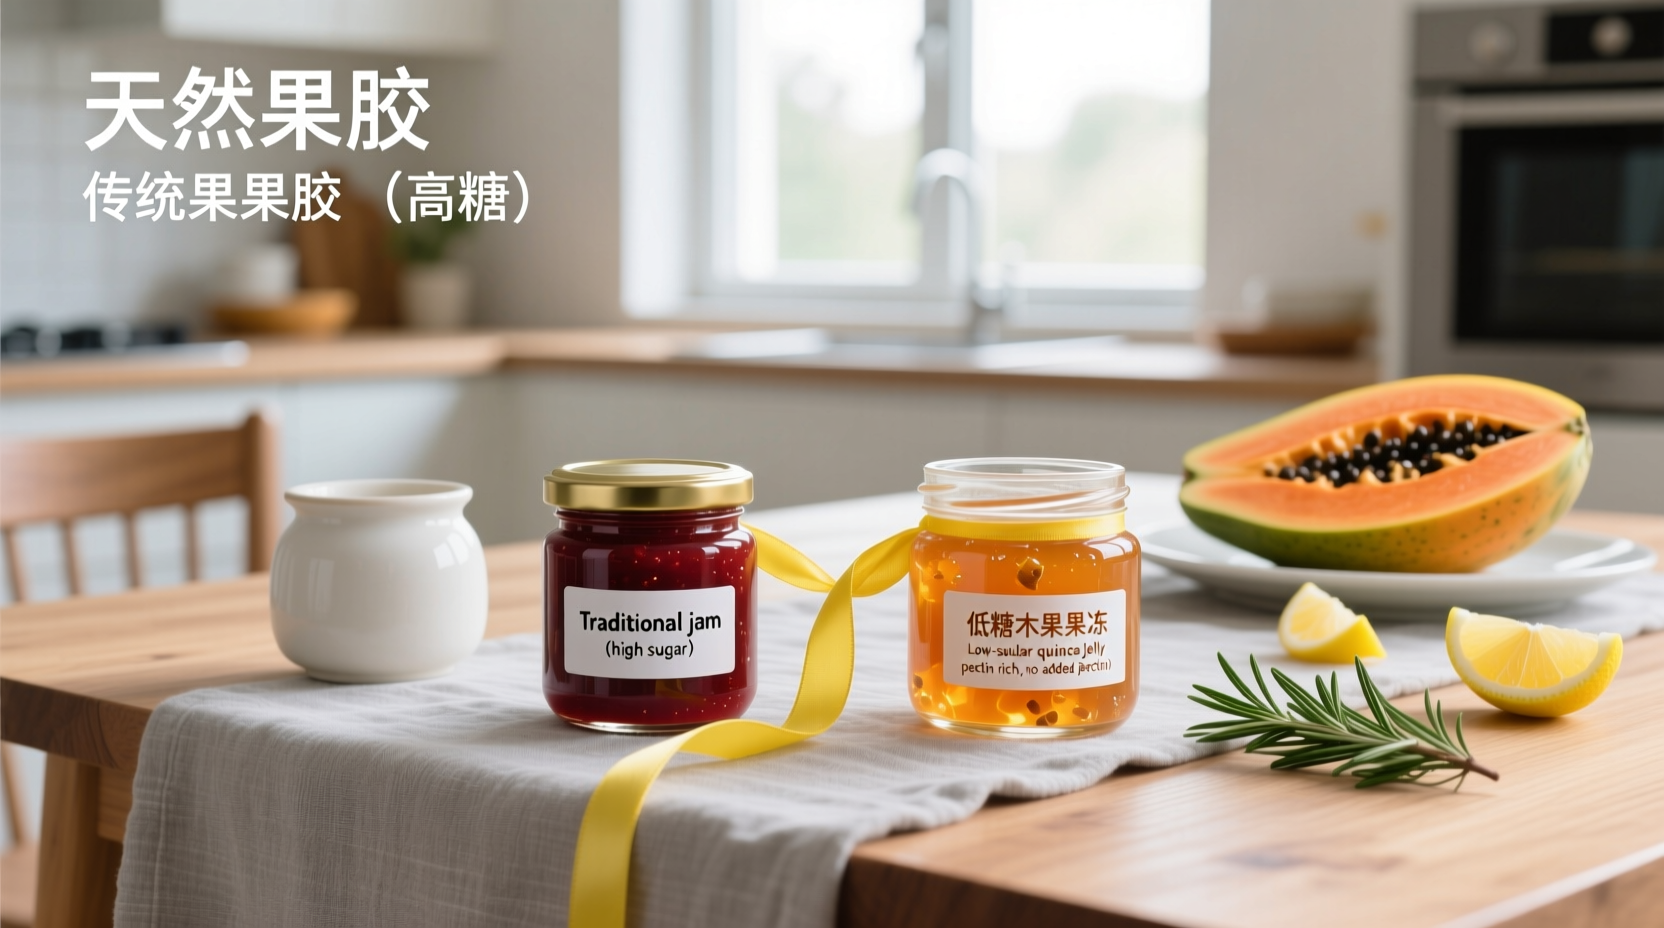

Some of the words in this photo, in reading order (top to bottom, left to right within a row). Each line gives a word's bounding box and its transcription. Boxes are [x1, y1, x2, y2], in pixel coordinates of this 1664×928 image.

[579, 611, 683, 632] Traditional
[687, 612, 722, 637] jam
[967, 610, 1108, 638] 低糖木果果冻
[605, 639, 643, 660] (high
[647, 639, 694, 660] sugar)
[998, 662, 1024, 677] rich,
[1026, 666, 1039, 675] no
[1042, 662, 1075, 675] added
